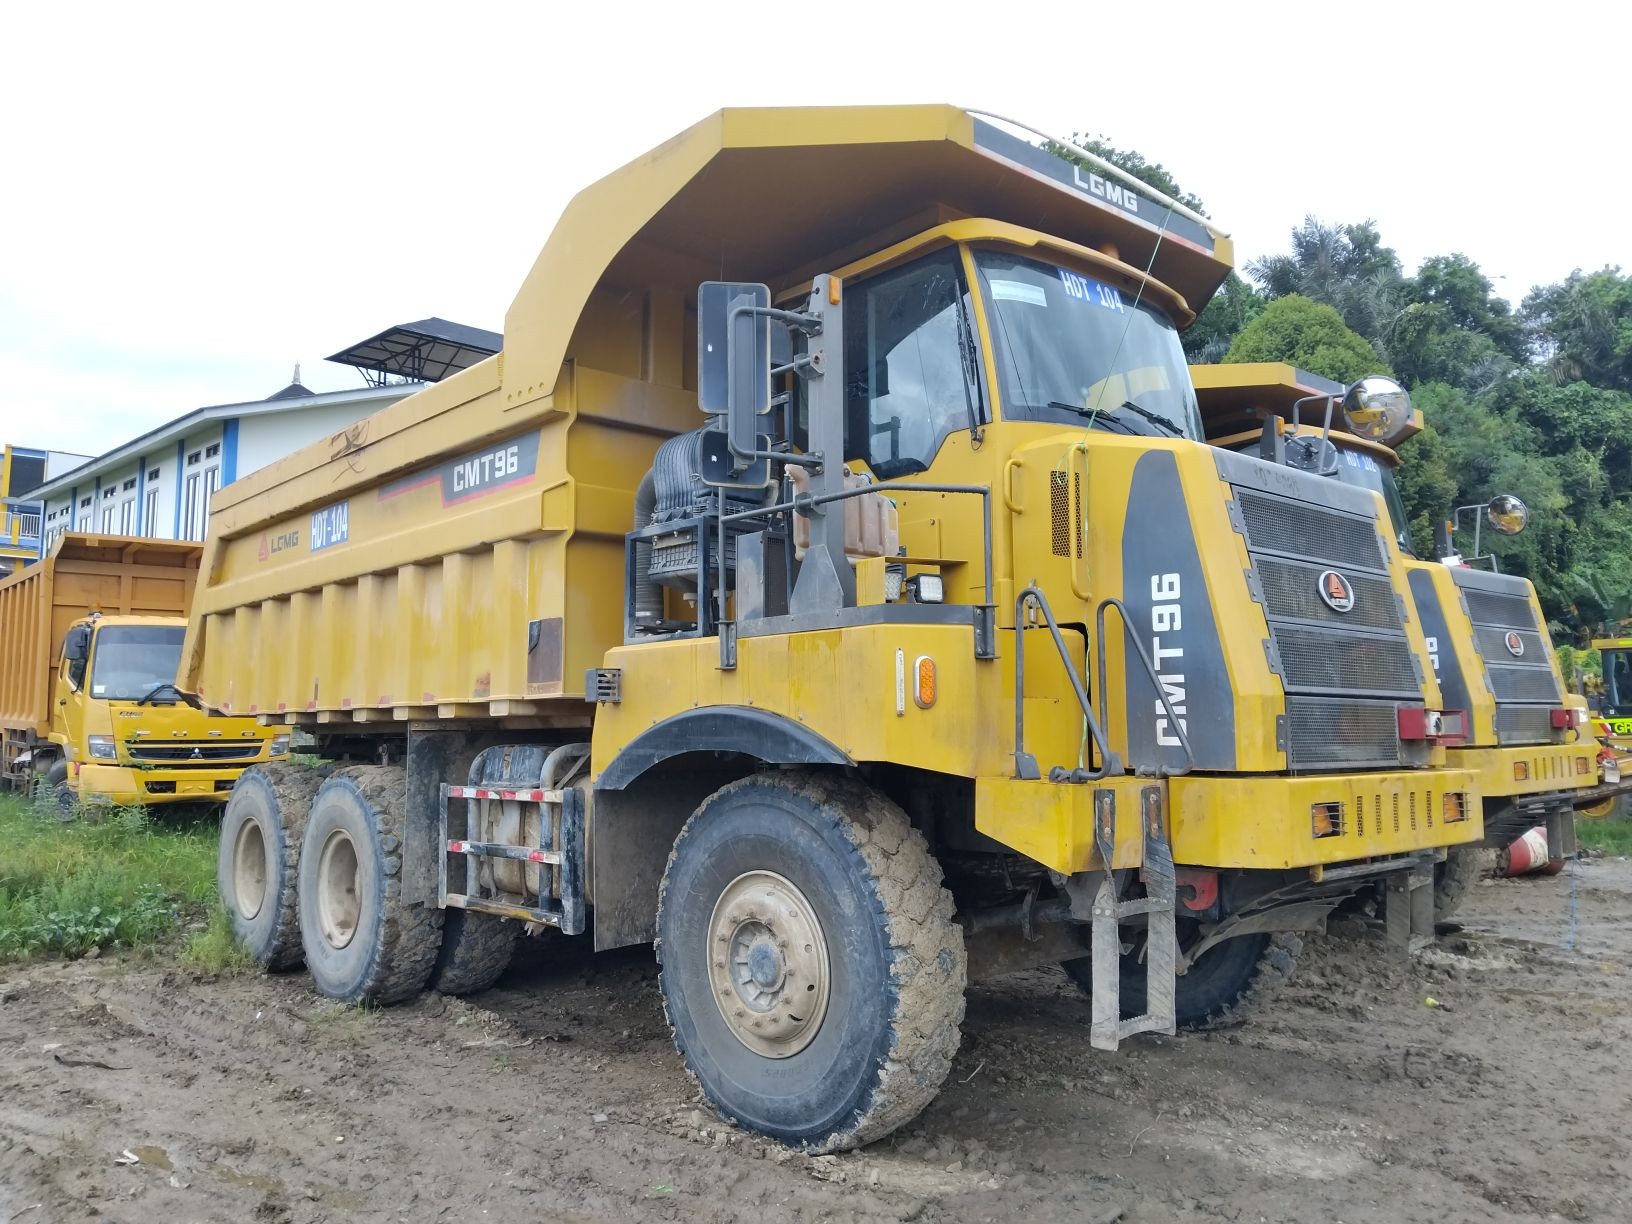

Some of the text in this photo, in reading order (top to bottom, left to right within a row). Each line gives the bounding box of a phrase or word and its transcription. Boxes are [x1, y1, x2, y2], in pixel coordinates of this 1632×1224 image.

[1073, 165, 1138, 212] LGMG
[1060, 270, 1124, 313] HDT 104
[453, 445, 518, 493] CMT96
[271, 530, 299, 553] LGMG
[311, 502, 348, 550] HDT-104
[1151, 573, 1187, 747] CMT96
